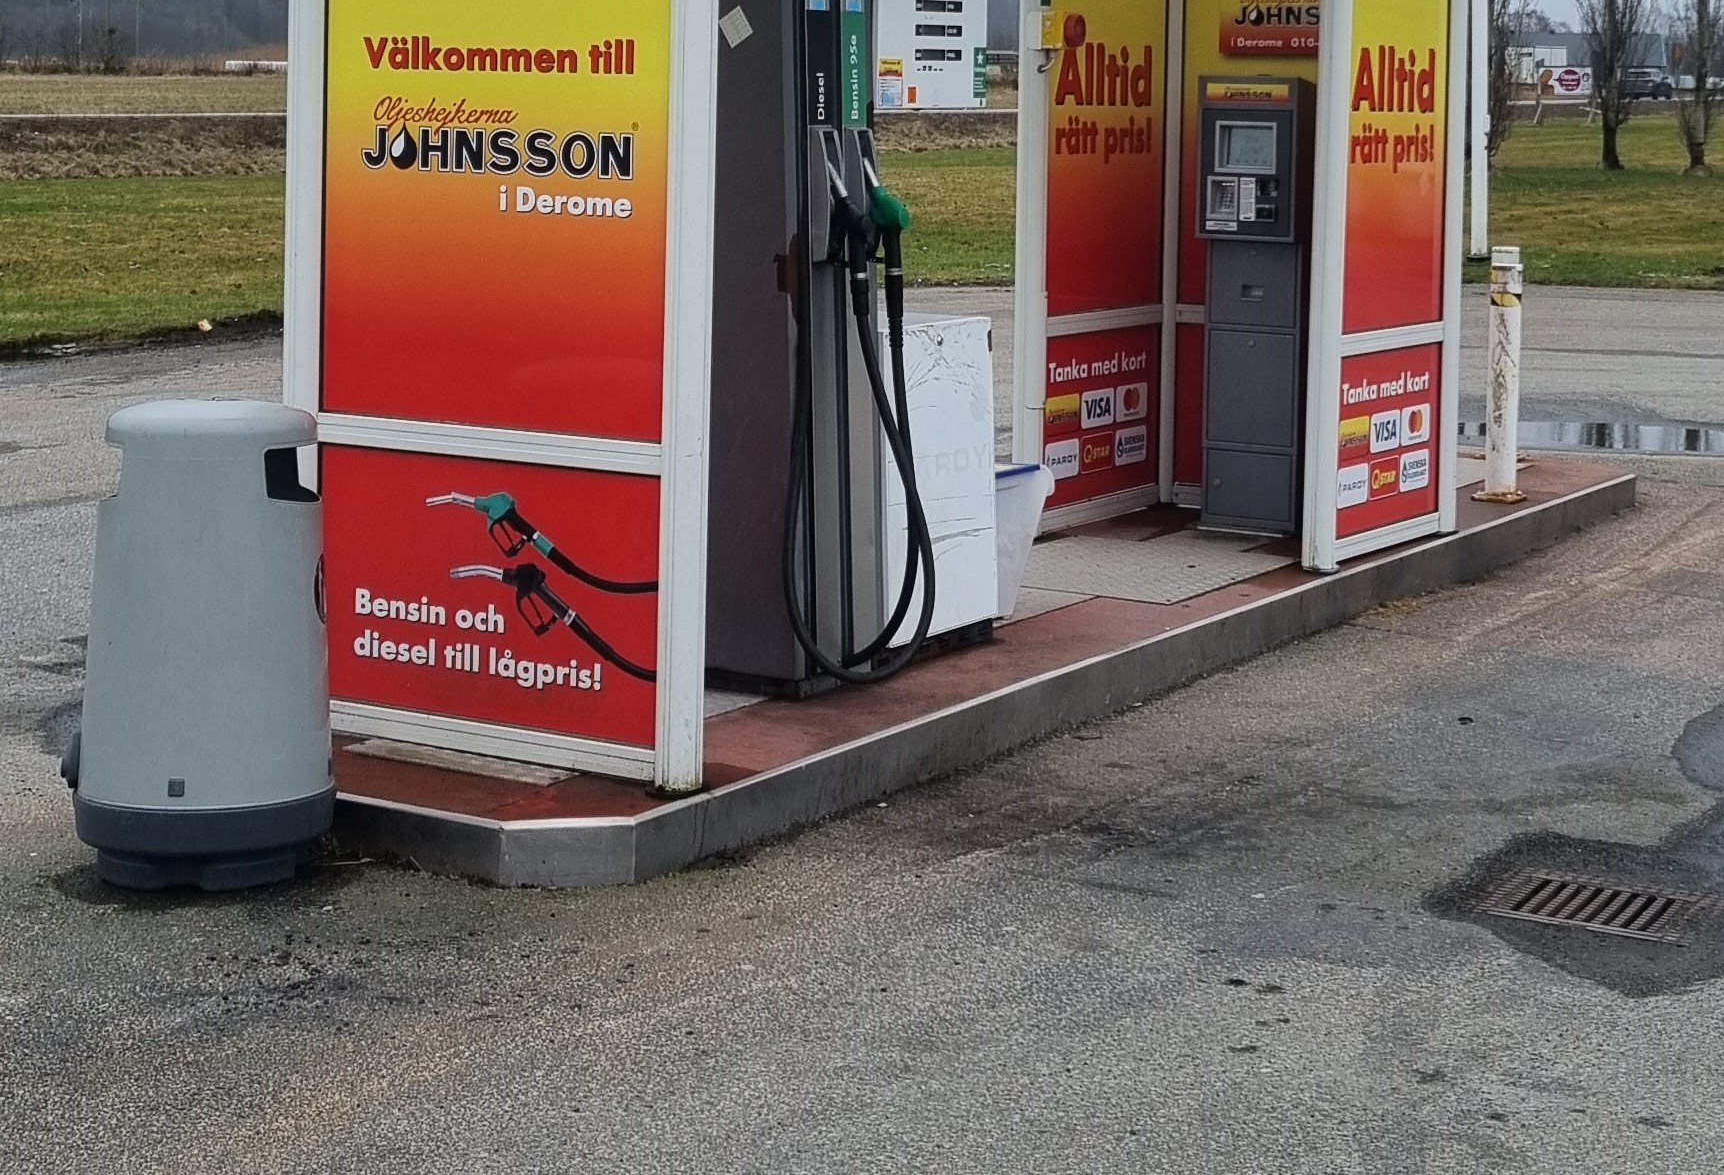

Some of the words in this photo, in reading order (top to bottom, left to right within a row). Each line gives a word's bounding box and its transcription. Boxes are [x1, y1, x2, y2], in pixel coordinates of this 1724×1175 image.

[362, 35, 578, 74] Välkommen
[588, 38, 635, 75] till
[1237, 37, 1283, 47] Derome
[815, 72, 825, 120] Diesel
[850, 69, 859, 120] Bensin
[1054, 42, 1153, 107] Alltid
[1351, 44, 1436, 114] Alltid
[372, 95, 519, 135] Oljeshejkerna
[361, 123, 634, 180] JOHNSSON
[1055, 115, 1099, 155] rätt
[1103, 115, 1152, 164] pris!
[1351, 122, 1388, 164] rätt
[1392, 122, 1435, 174] pris!
[499, 184, 508, 211] i
[515, 186, 633, 219] Derome
[1049, 358, 1088, 383] Tanka
[1091, 352, 1118, 377] med
[1121, 351, 1147, 371] kort
[1341, 378, 1377, 405] Tanka
[1379, 372, 1405, 398] med
[1406, 371, 1430, 393] kort
[1084, 396, 1112, 420] VISA
[1373, 418, 1398, 443] VISA
[354, 588, 447, 626] Bensin
[454, 603, 505, 633] och
[353, 629, 436, 666] diesel
[444, 643, 480, 674] till
[489, 646, 602, 691] lågpris!
